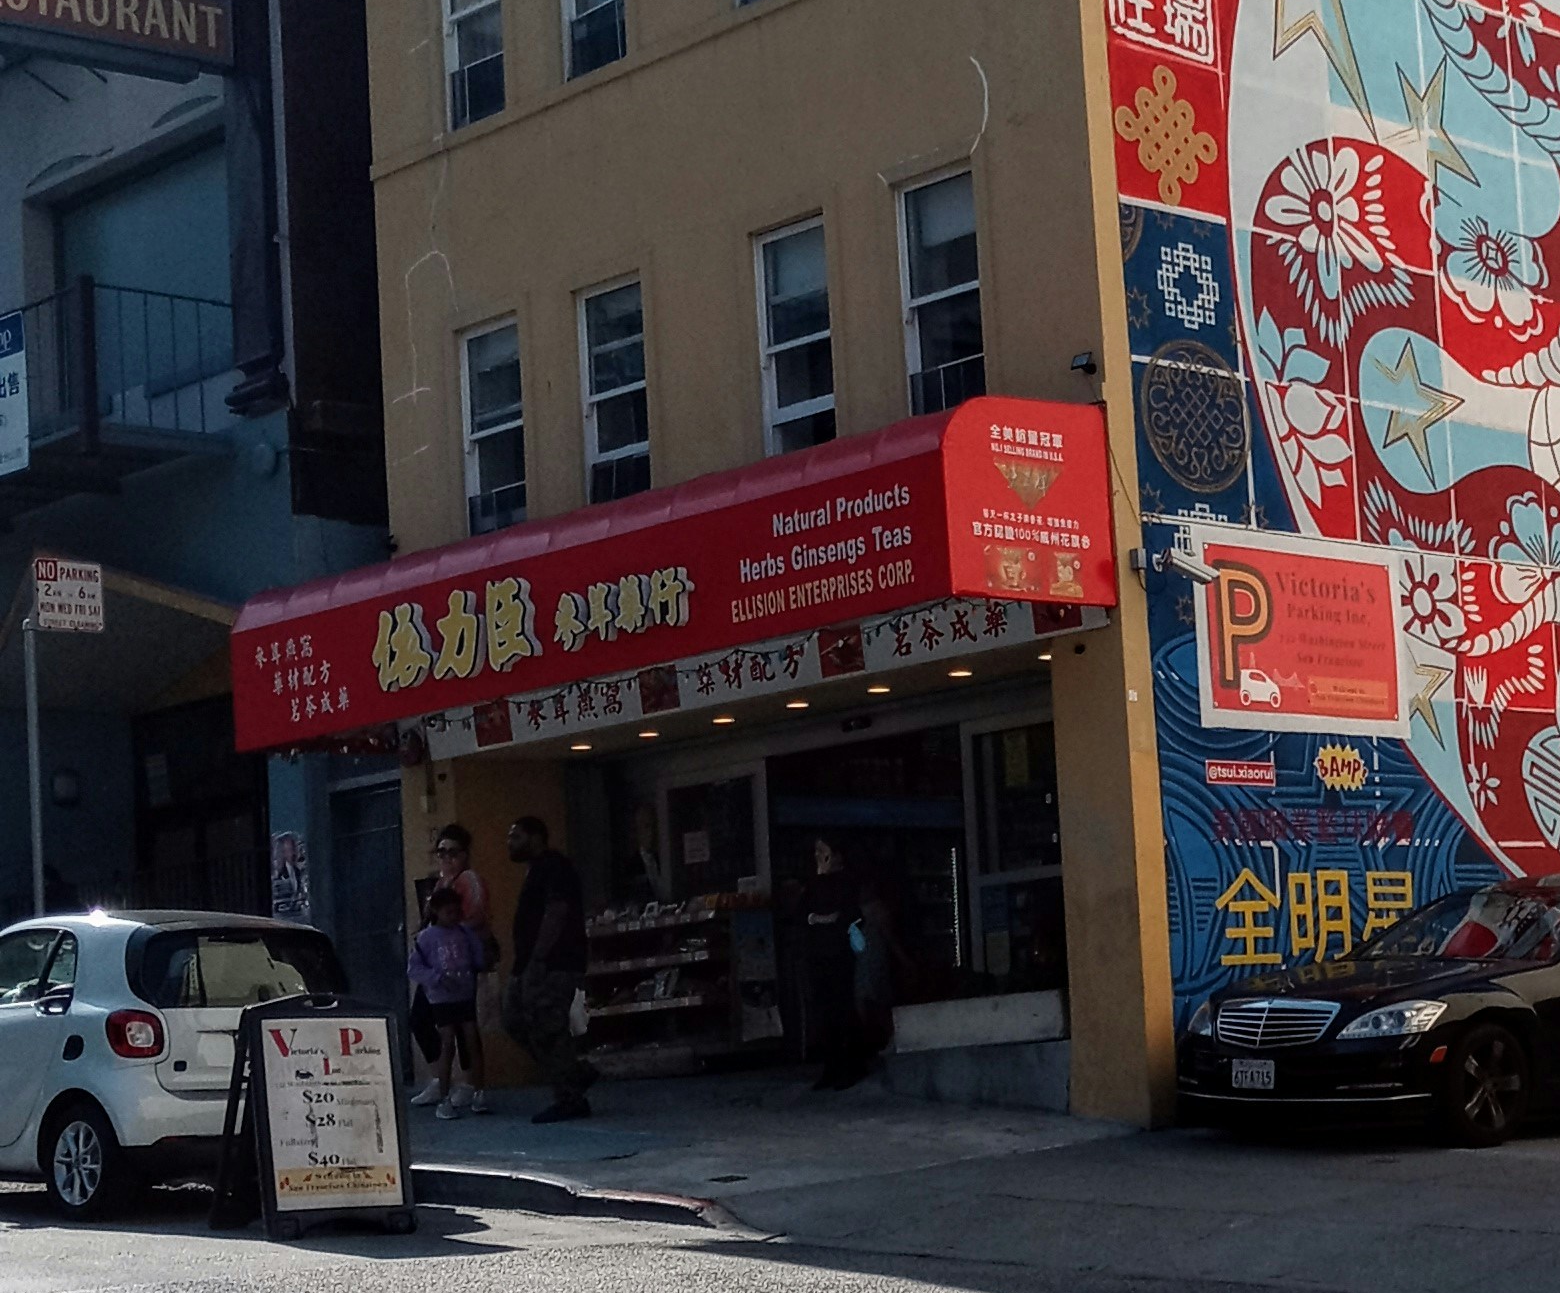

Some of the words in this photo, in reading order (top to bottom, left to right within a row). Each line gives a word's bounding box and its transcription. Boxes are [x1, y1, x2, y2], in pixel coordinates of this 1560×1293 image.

[771, 499, 831, 539] Natural
[835, 482, 911, 522] Products
[739, 552, 786, 584] Herbs
[790, 535, 867, 572] Ginsengs
[871, 524, 913, 552] Teas
[38, 560, 56, 580] NO
[59, 566, 100, 583] PARKING
[730, 588, 786, 624] ELLISION
[788, 567, 875, 611] ENTERPRISES
[877, 558, 916, 590] CORP.
[1275, 570, 1376, 604] Victoria's
[1286, 603, 1342, 624] Parking
[1316, 755, 1368, 784] BAMP!
[1214, 866, 1414, 967] 全明星
[301, 1089, 335, 1105] $20
[304, 1112, 337, 1127] $28
[307, 1151, 340, 1167] $40
